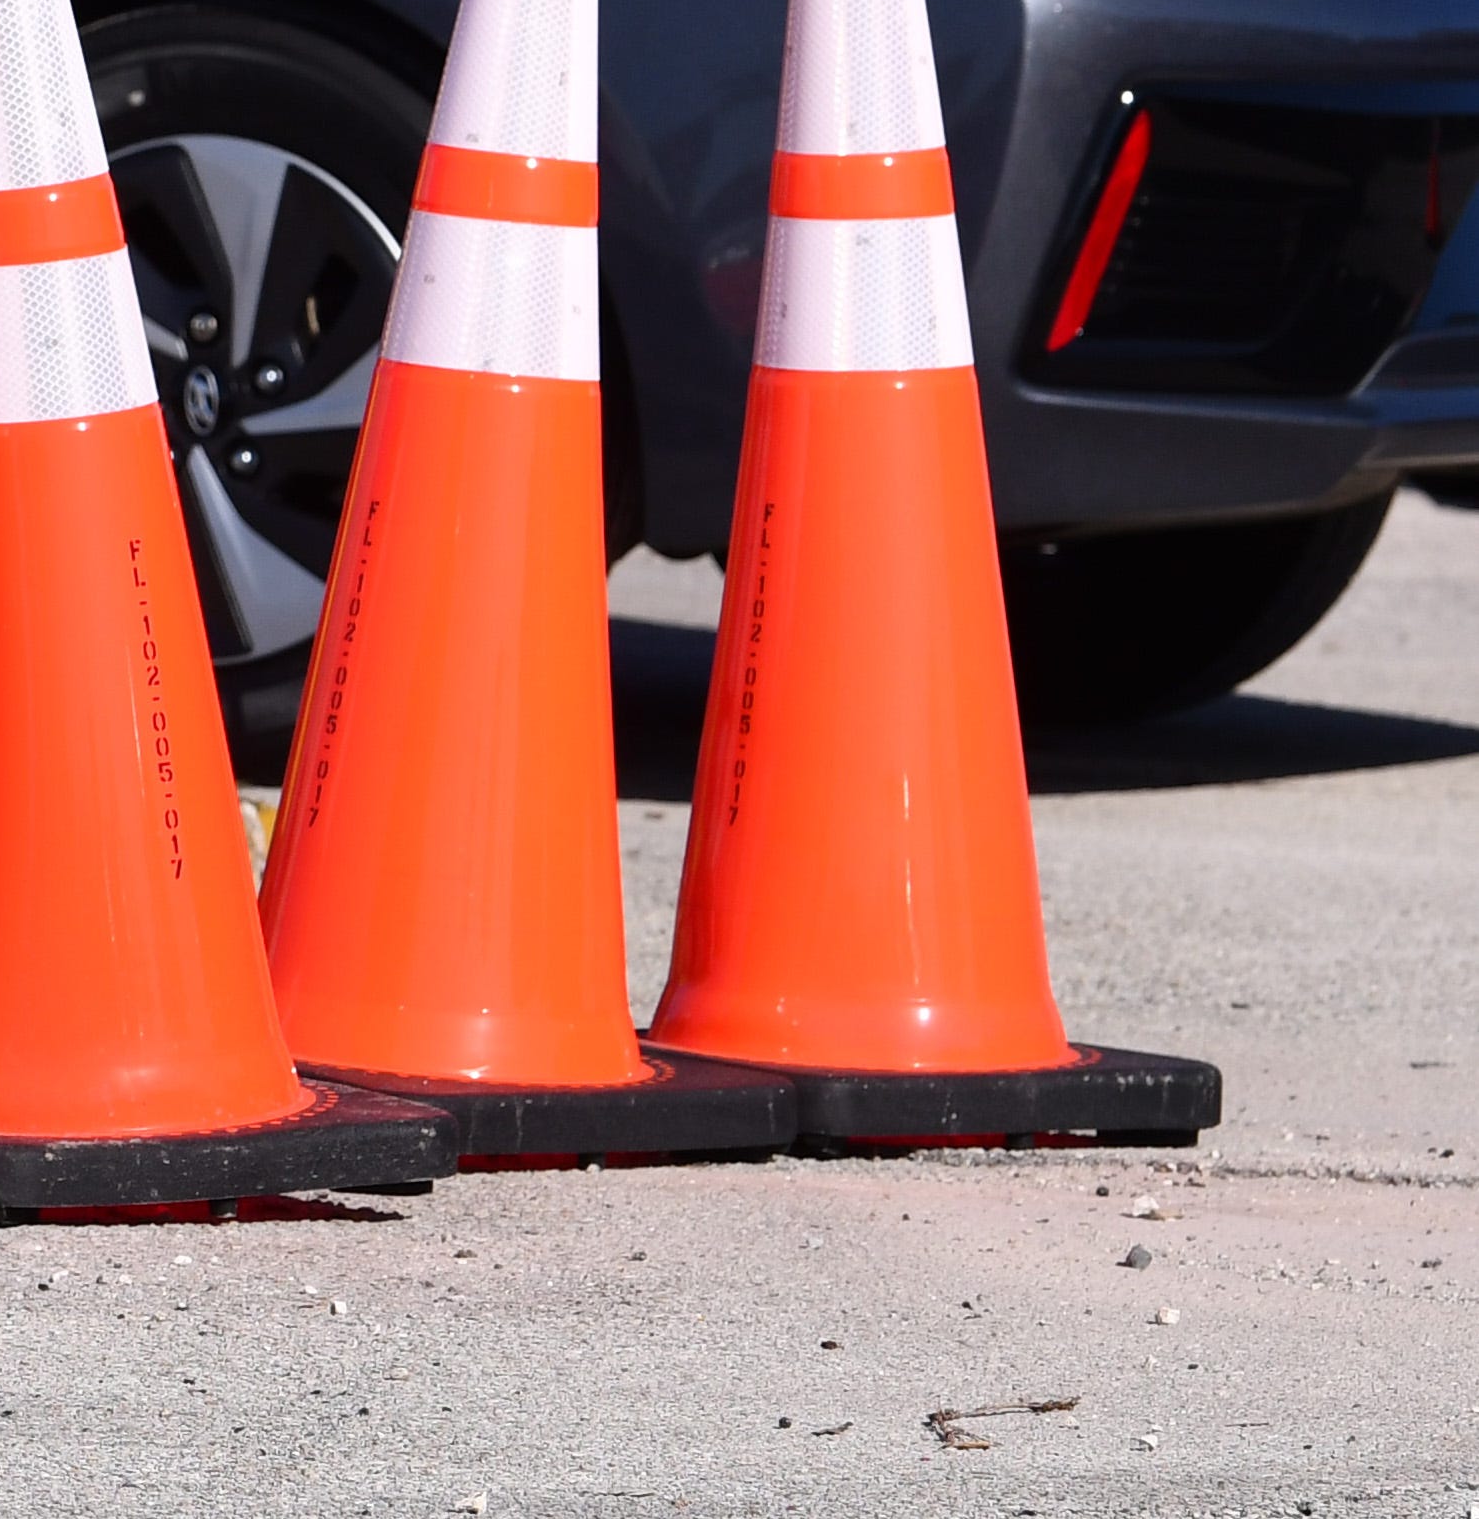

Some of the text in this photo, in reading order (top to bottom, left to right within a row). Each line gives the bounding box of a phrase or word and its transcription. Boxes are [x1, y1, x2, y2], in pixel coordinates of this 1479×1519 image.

[128, 538, 185, 881] FL-102-005-017
[307, 499, 381, 829] FL-102-005-017
[728, 501, 776, 828] FL-102-005-017
